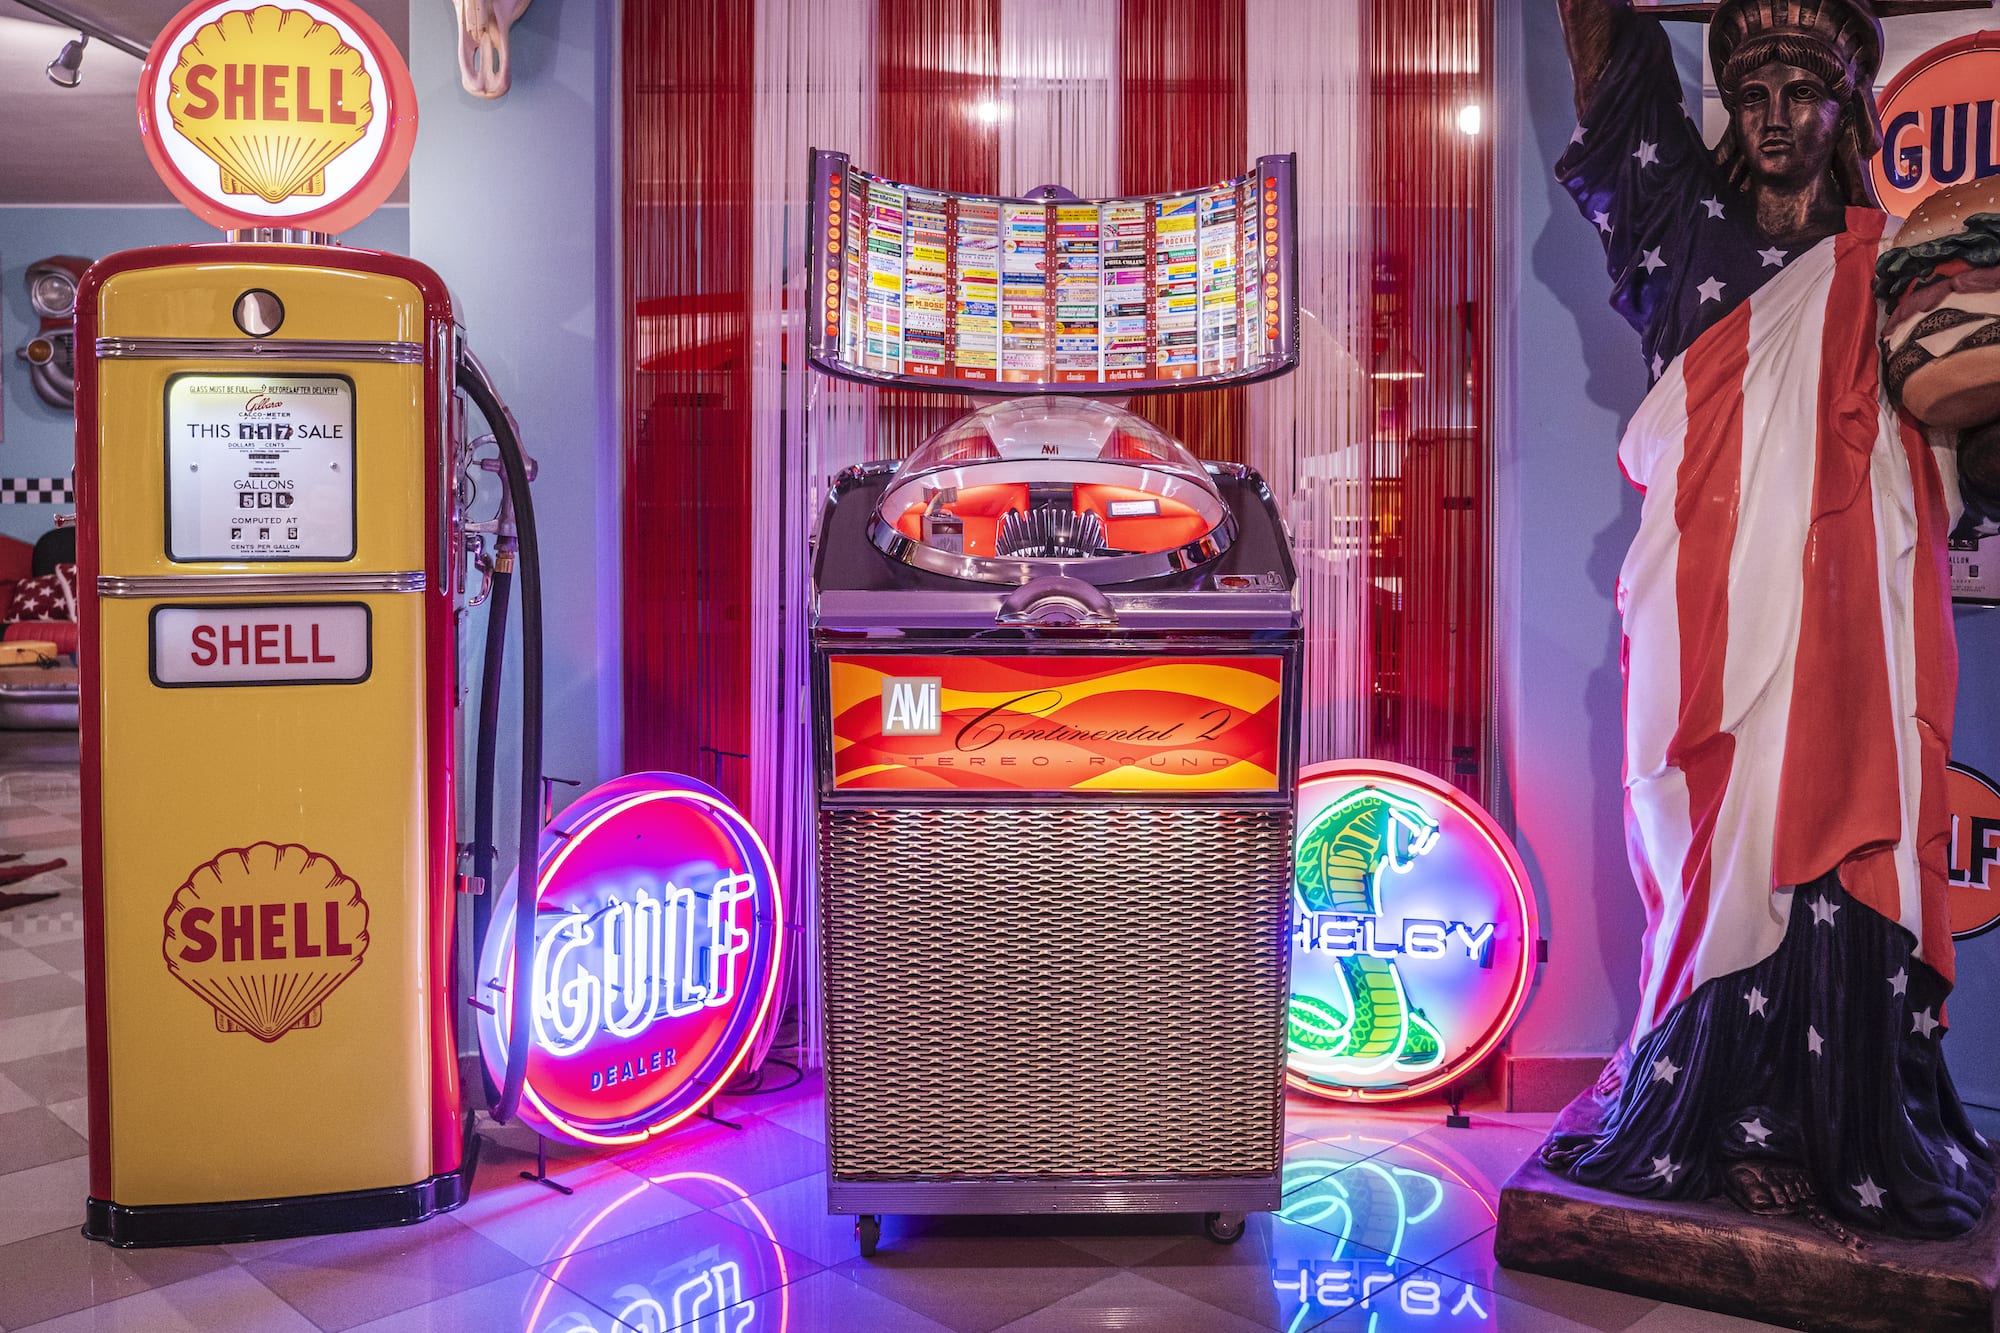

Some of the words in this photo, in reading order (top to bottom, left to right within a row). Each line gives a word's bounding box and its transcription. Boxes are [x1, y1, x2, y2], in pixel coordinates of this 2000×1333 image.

[183, 63, 357, 125] SHELL
[1883, 100, 2000, 191] GUL
[190, 385, 208, 393] GLASS
[209, 385, 225, 393] MUST
[227, 385, 235, 393] BE
[235, 385, 249, 394] FULL
[312, 386, 338, 395] DELIVERY
[187, 423, 231, 438] THIS
[297, 424, 344, 439] SALE
[233, 479, 295, 490] GALLONS
[191, 623, 336, 666] SHELL
[954, 690, 1185, 752] Continental
[1195, 708, 1232, 741] 2
[1947, 813, 2000, 889] LF
[179, 901, 353, 964] SHELL
[1292, 918, 1495, 961] HELBY
[531, 873, 755, 1057] GULF
[591, 1050, 677, 1092] DEALER
